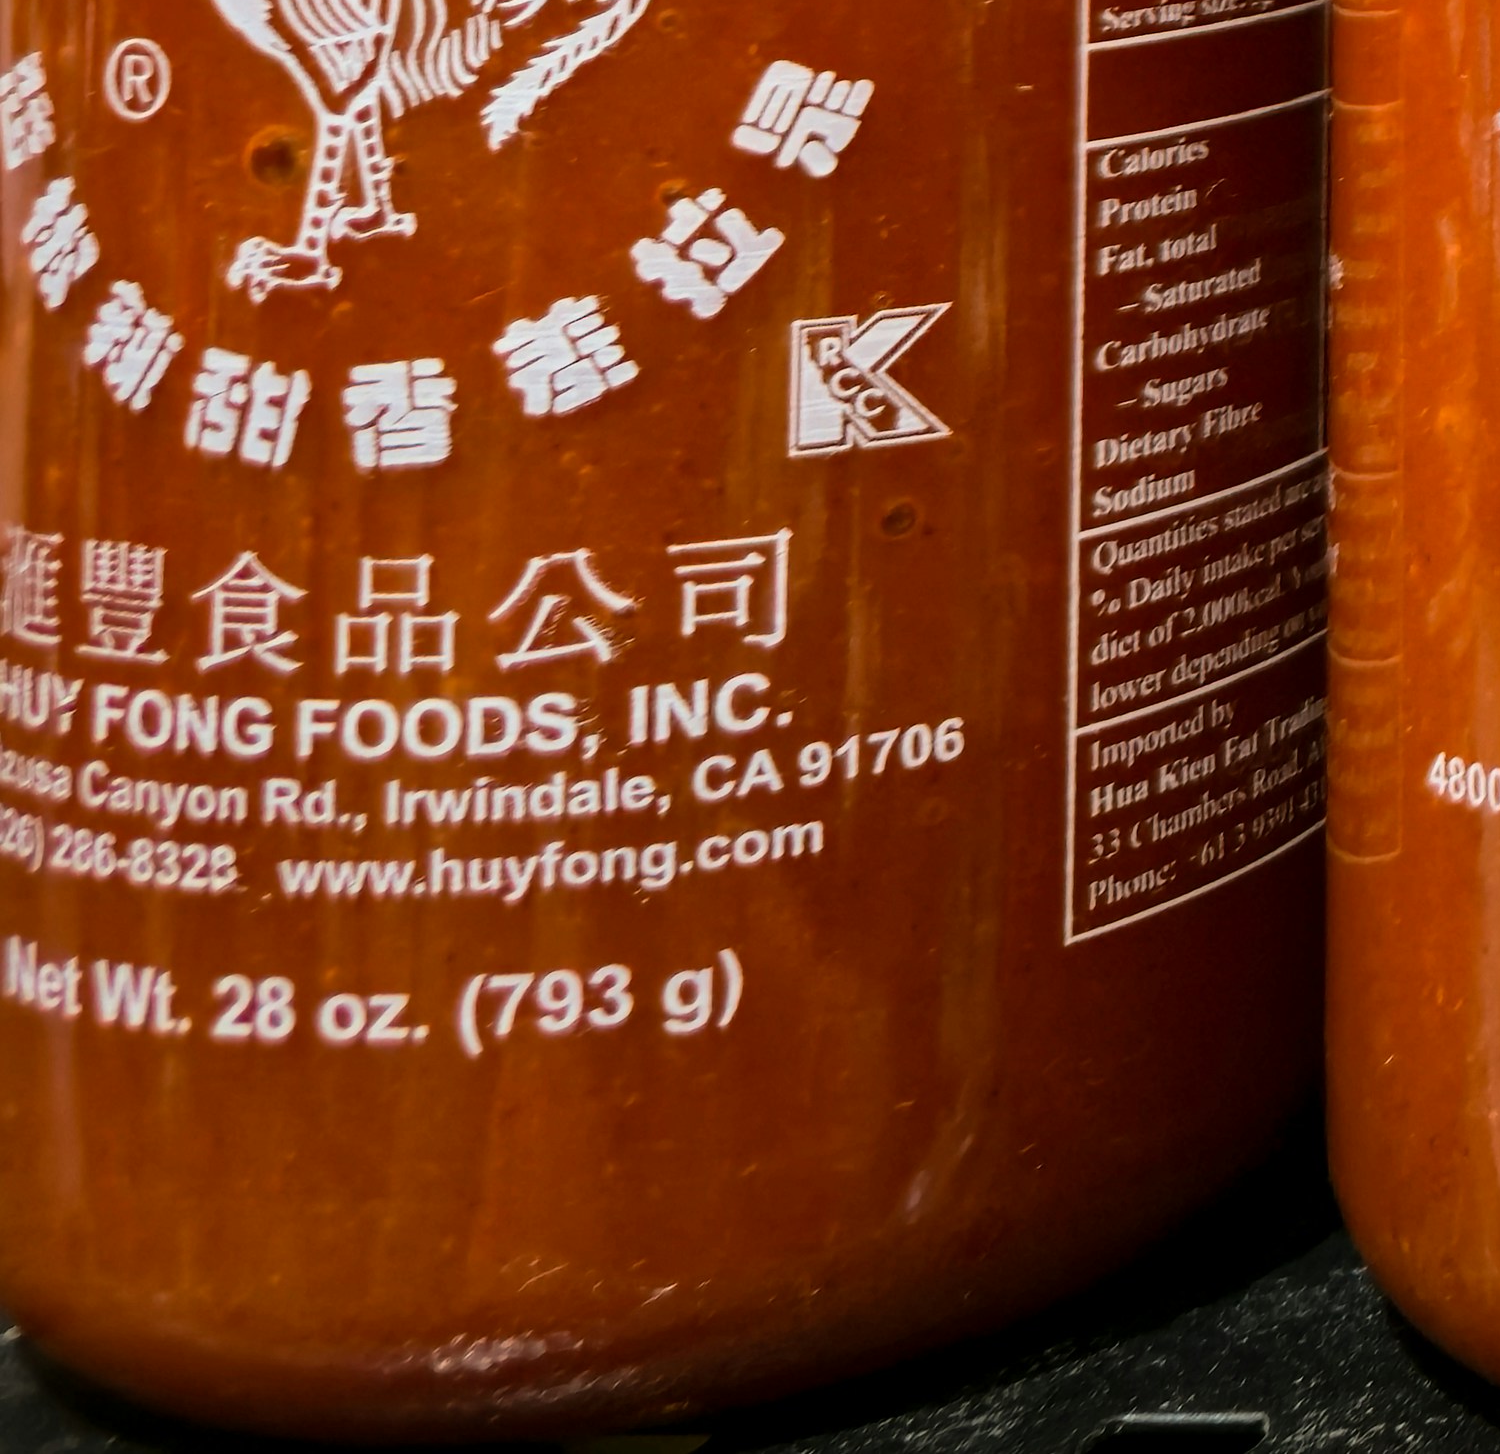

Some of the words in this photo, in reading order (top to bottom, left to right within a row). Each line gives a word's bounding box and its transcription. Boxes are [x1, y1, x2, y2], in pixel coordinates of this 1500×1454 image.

[1099, 137, 1210, 179] Calories
[1099, 185, 1198, 229] Protein
[1096, 306, 1270, 372] Carbohydrate
[1094, 421, 1195, 468] Dietary
[1200, 400, 1263, 439] Fibre
[1094, 471, 1196, 517] Sodium
[1094, 521, 1219, 574] Quantities
[1127, 563, 1196, 610] Daily
[0, 658, 84, 737] HUY
[93, 683, 275, 759] FONG
[295, 689, 602, 760] FOODS,
[626, 671, 794, 747] INC.
[1090, 668, 1165, 712] lower
[1092, 713, 1203, 769] Imported
[79, 759, 249, 829] Canyon
[384, 768, 673, 830] Irwindale,
[690, 751, 782, 804] CA
[798, 716, 967, 790] 91706
[1090, 778, 1149, 817] Hua
[1130, 787, 1246, 849] Chambers
[49, 822, 239, 892] 286-8328
[277, 818, 826, 905] www.huyfong.com
[1088, 865, 1176, 910] Phone:
[3, 934, 83, 1017] Net
[91, 957, 193, 1035] Wt.
[210, 974, 297, 1041] 28
[315, 990, 430, 1044] oz.
[457, 962, 635, 1055] (793
[662, 948, 743, 1033] g)
